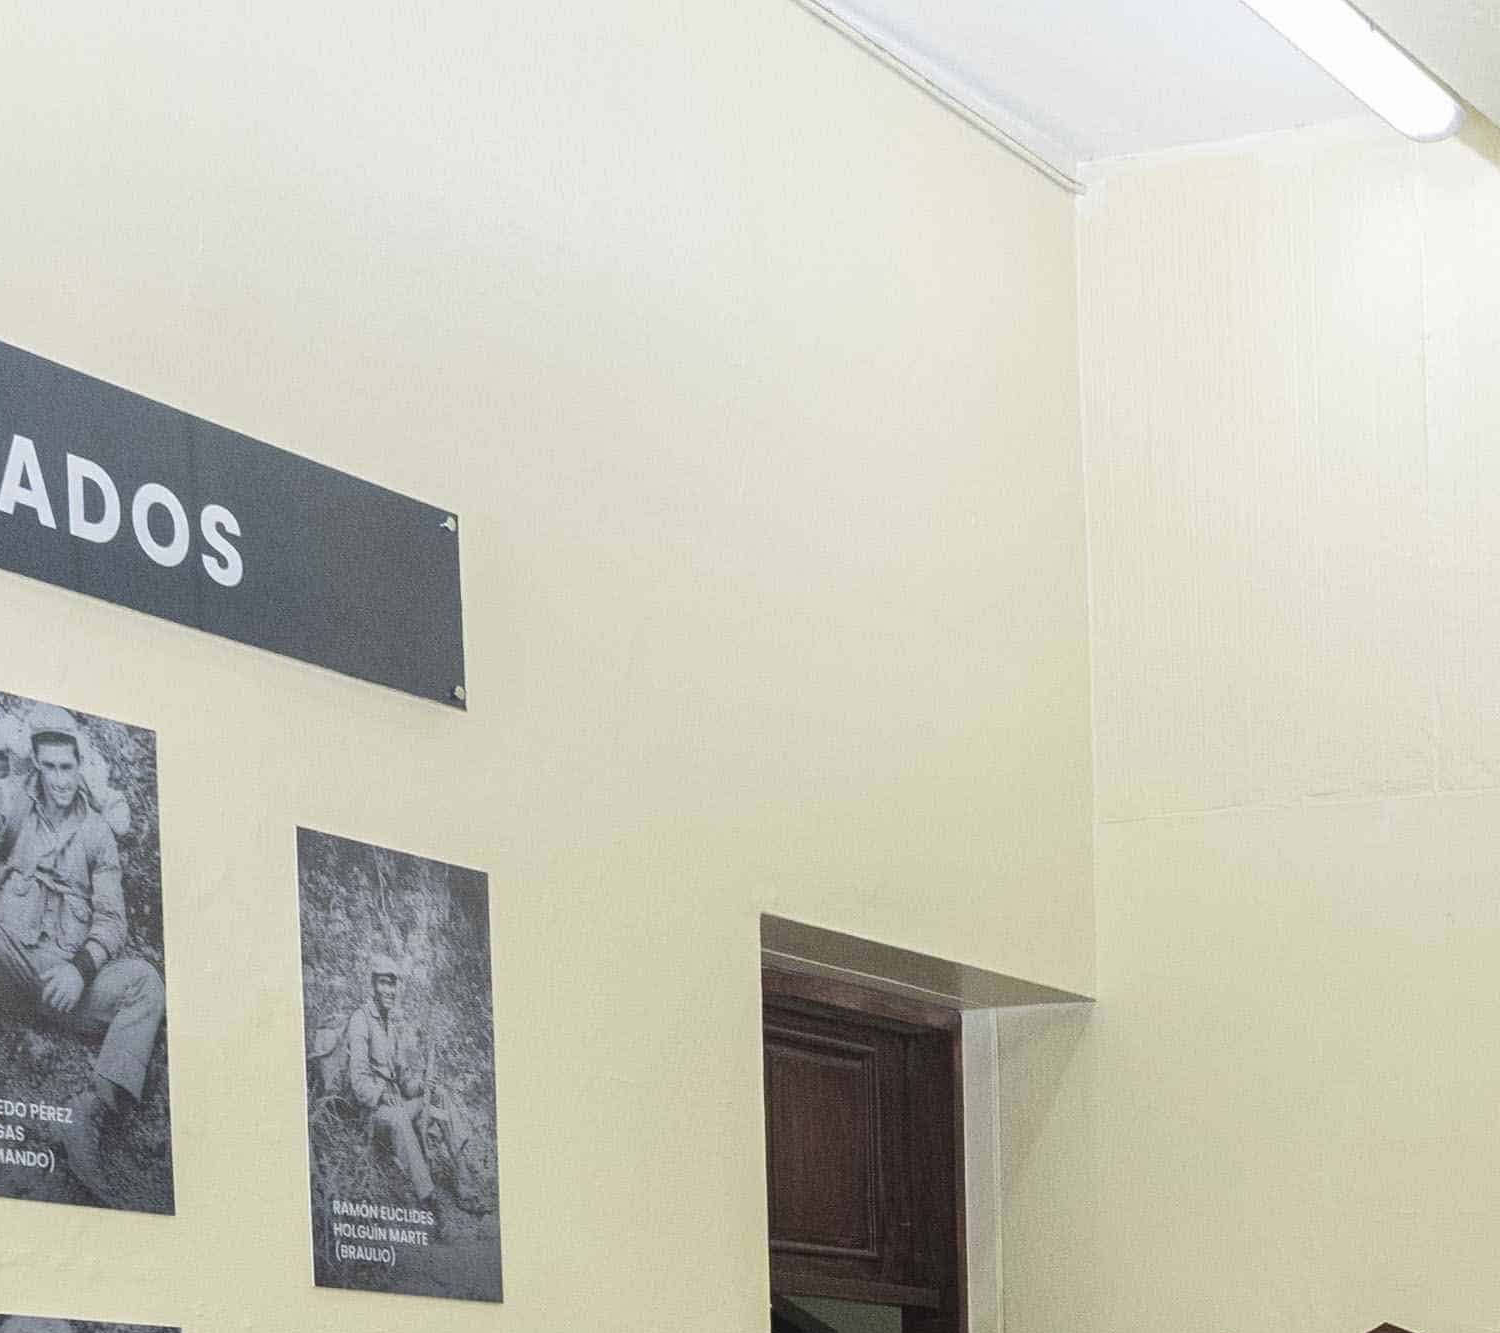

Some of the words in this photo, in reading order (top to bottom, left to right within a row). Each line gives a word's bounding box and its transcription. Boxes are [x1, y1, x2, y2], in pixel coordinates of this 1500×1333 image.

[30, 1101, 73, 1124] PÉREZ
[333, 1200, 378, 1219] RAMÓN
[380, 1205, 434, 1225] EUCLIDES
[333, 1222, 387, 1241] HOLGUÍN
[389, 1228, 428, 1246] MARTE
[335, 1240, 396, 1267] (BRAULIO)
